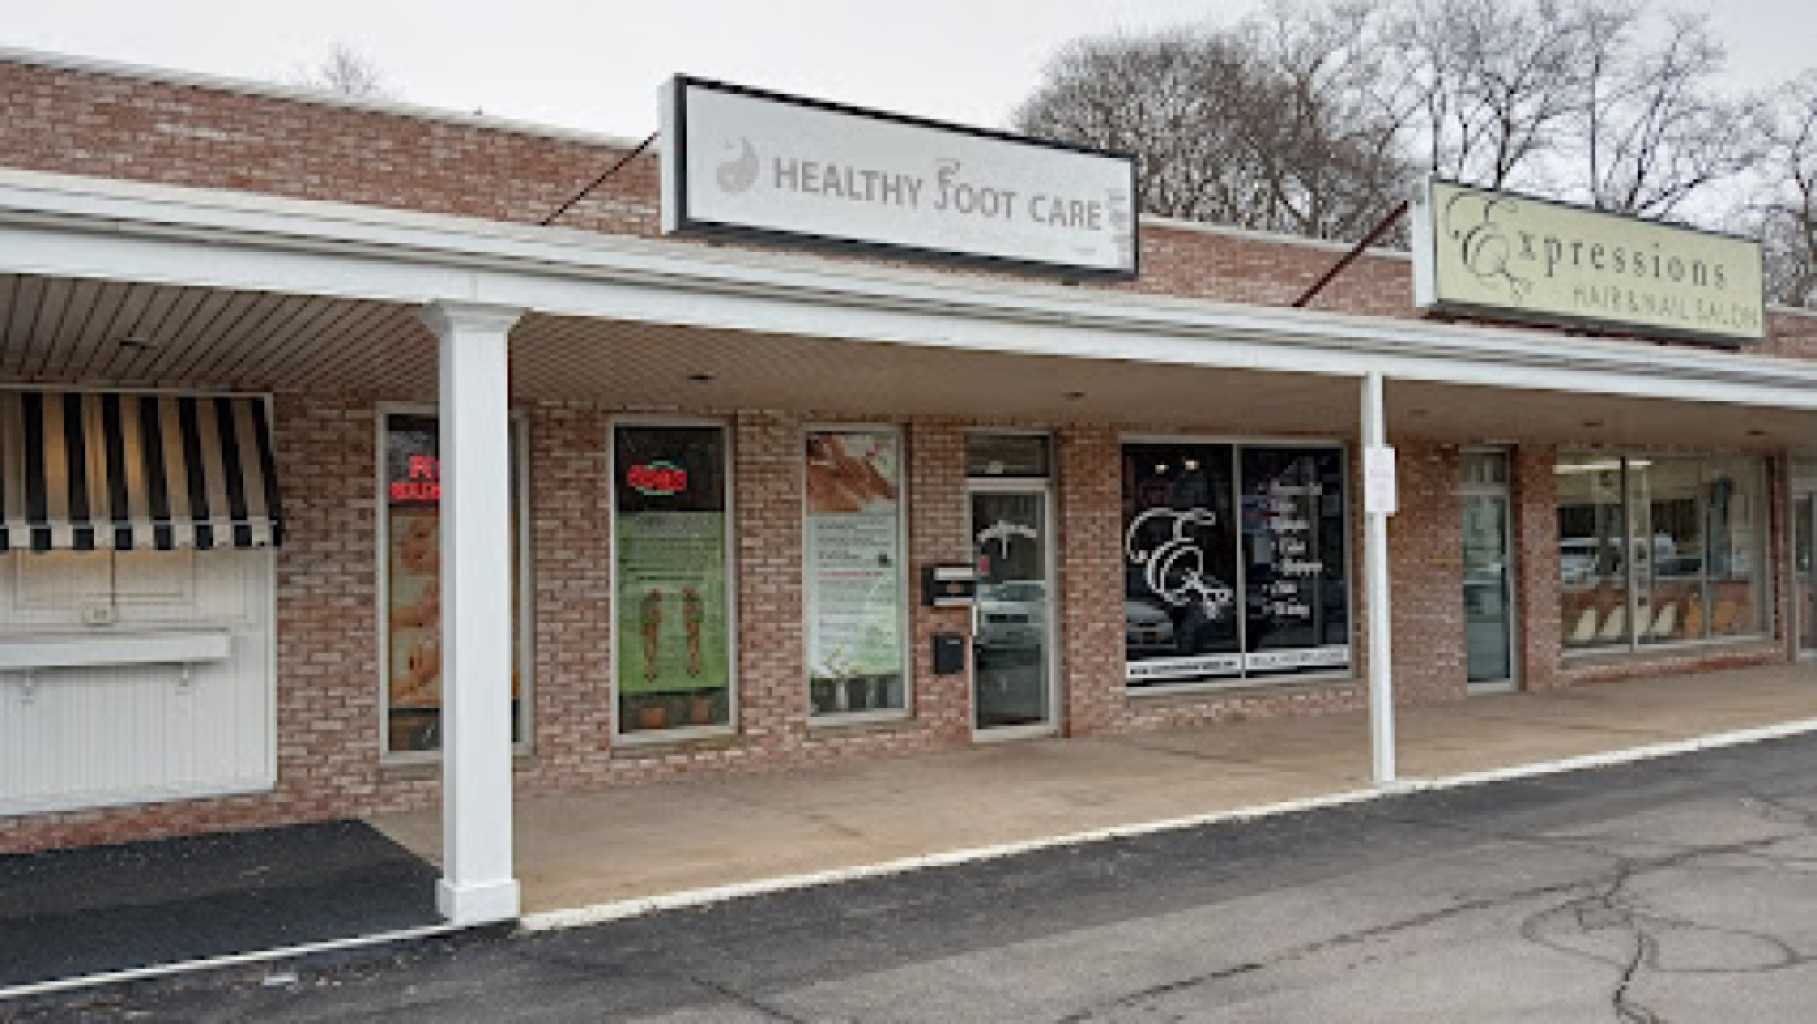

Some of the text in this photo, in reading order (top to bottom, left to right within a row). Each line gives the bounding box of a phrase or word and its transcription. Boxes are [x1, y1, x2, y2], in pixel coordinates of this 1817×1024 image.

[772, 156, 923, 210] HEALTHY
[933, 157, 1018, 218] FOOT
[1028, 194, 1102, 231] CARE
[1446, 191, 1727, 302] Expressions
